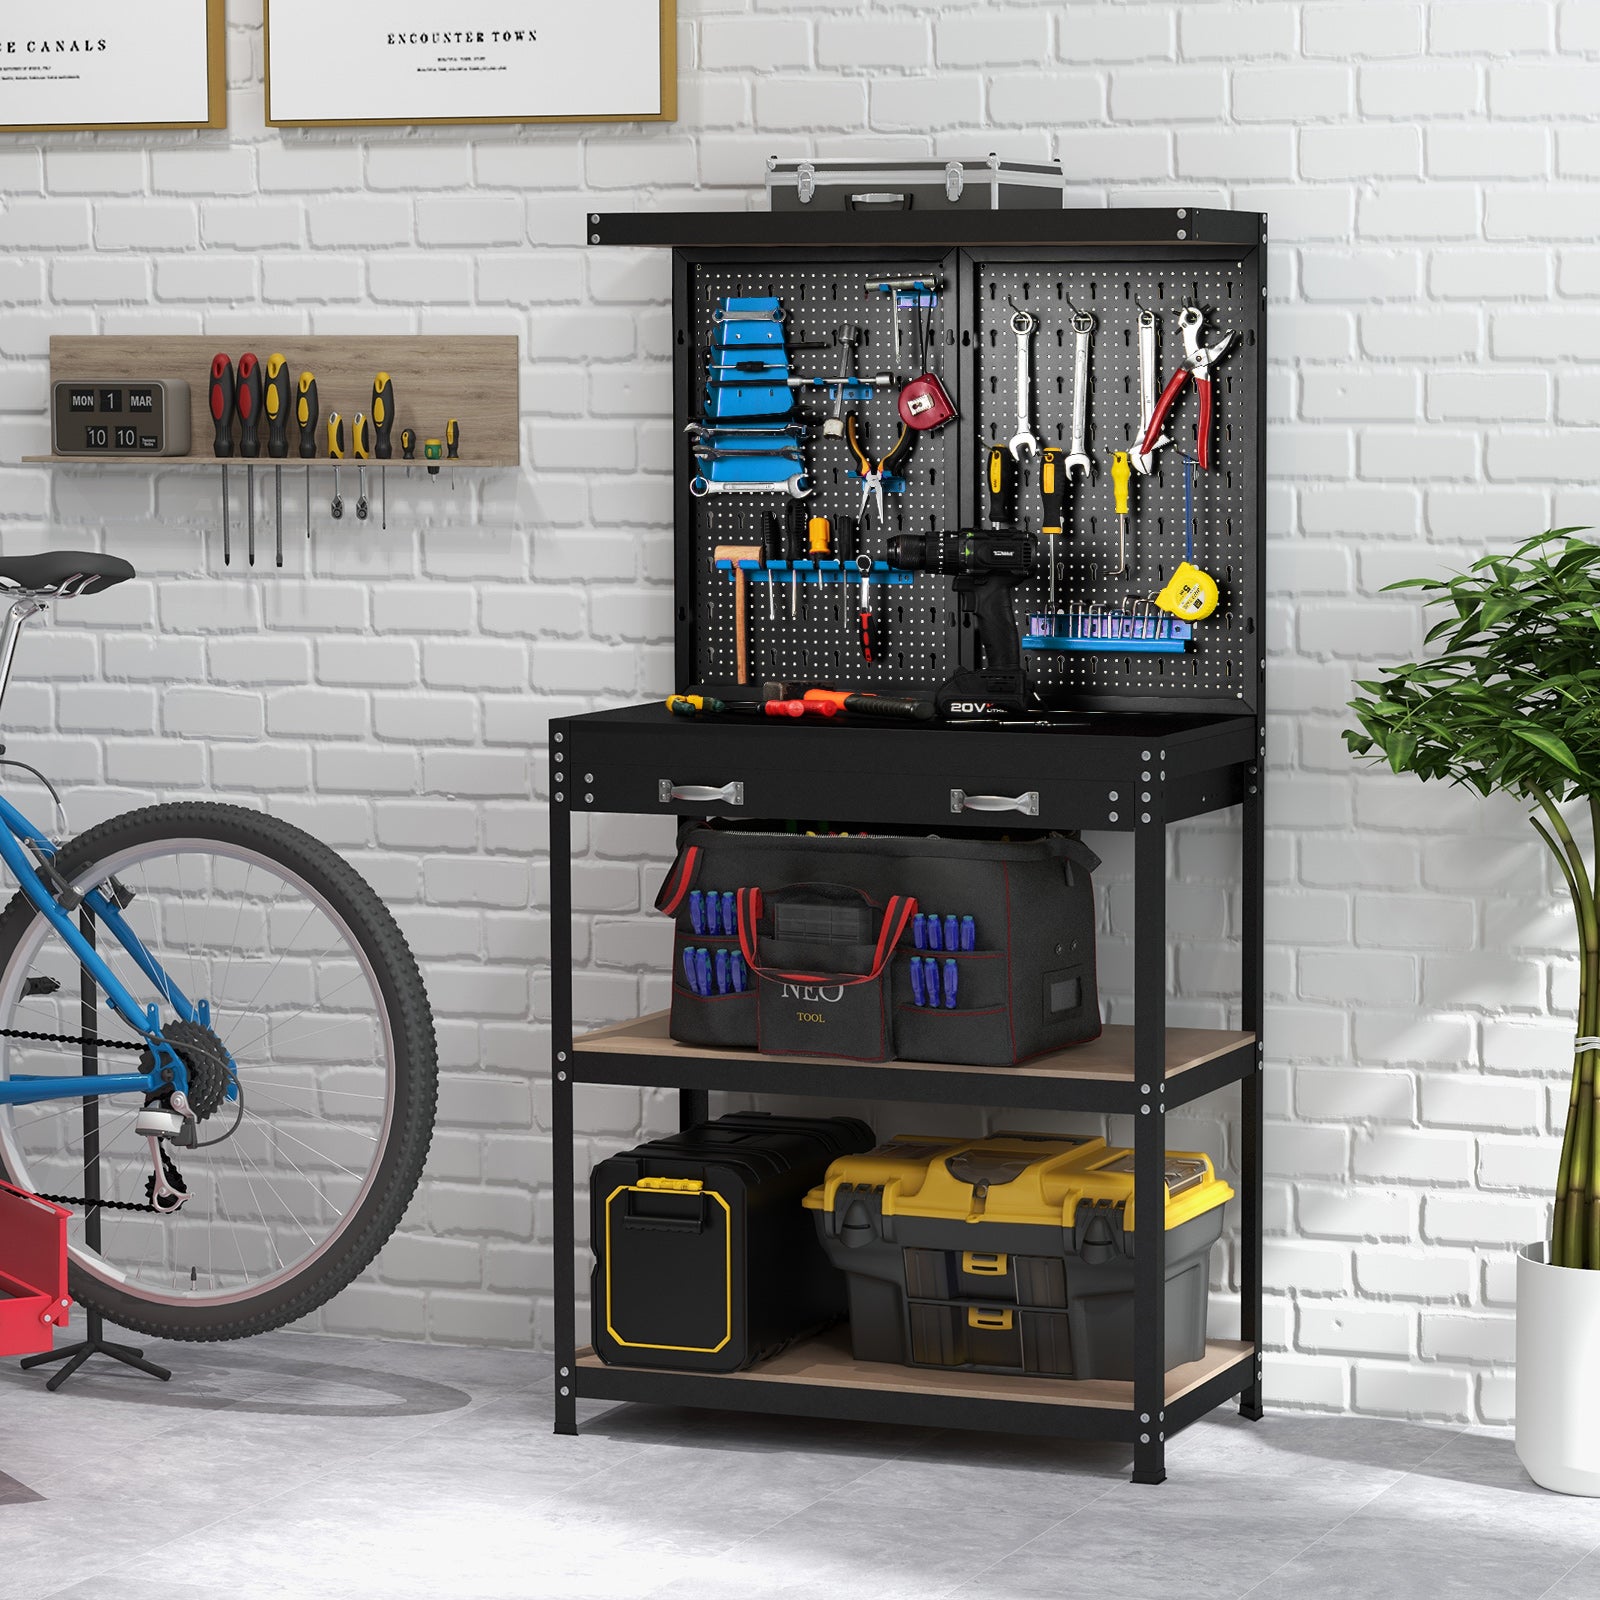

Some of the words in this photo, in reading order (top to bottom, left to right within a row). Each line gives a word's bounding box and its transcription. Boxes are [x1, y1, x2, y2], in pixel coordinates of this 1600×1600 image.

[387, 31, 485, 44] ENCOUNTER
[491, 30, 537, 42] TOWN
[26, 38, 107, 53] CANALS
[72, 395, 94, 407] MON
[107, 393, 114, 409] 1
[130, 395, 153, 407] MAR
[88, 429, 106, 445] 10
[117, 429, 135, 446] 10
[950, 702, 986, 713] 20V
[781, 983, 844, 1003] NEO
[796, 1012, 826, 1023] TOOL
